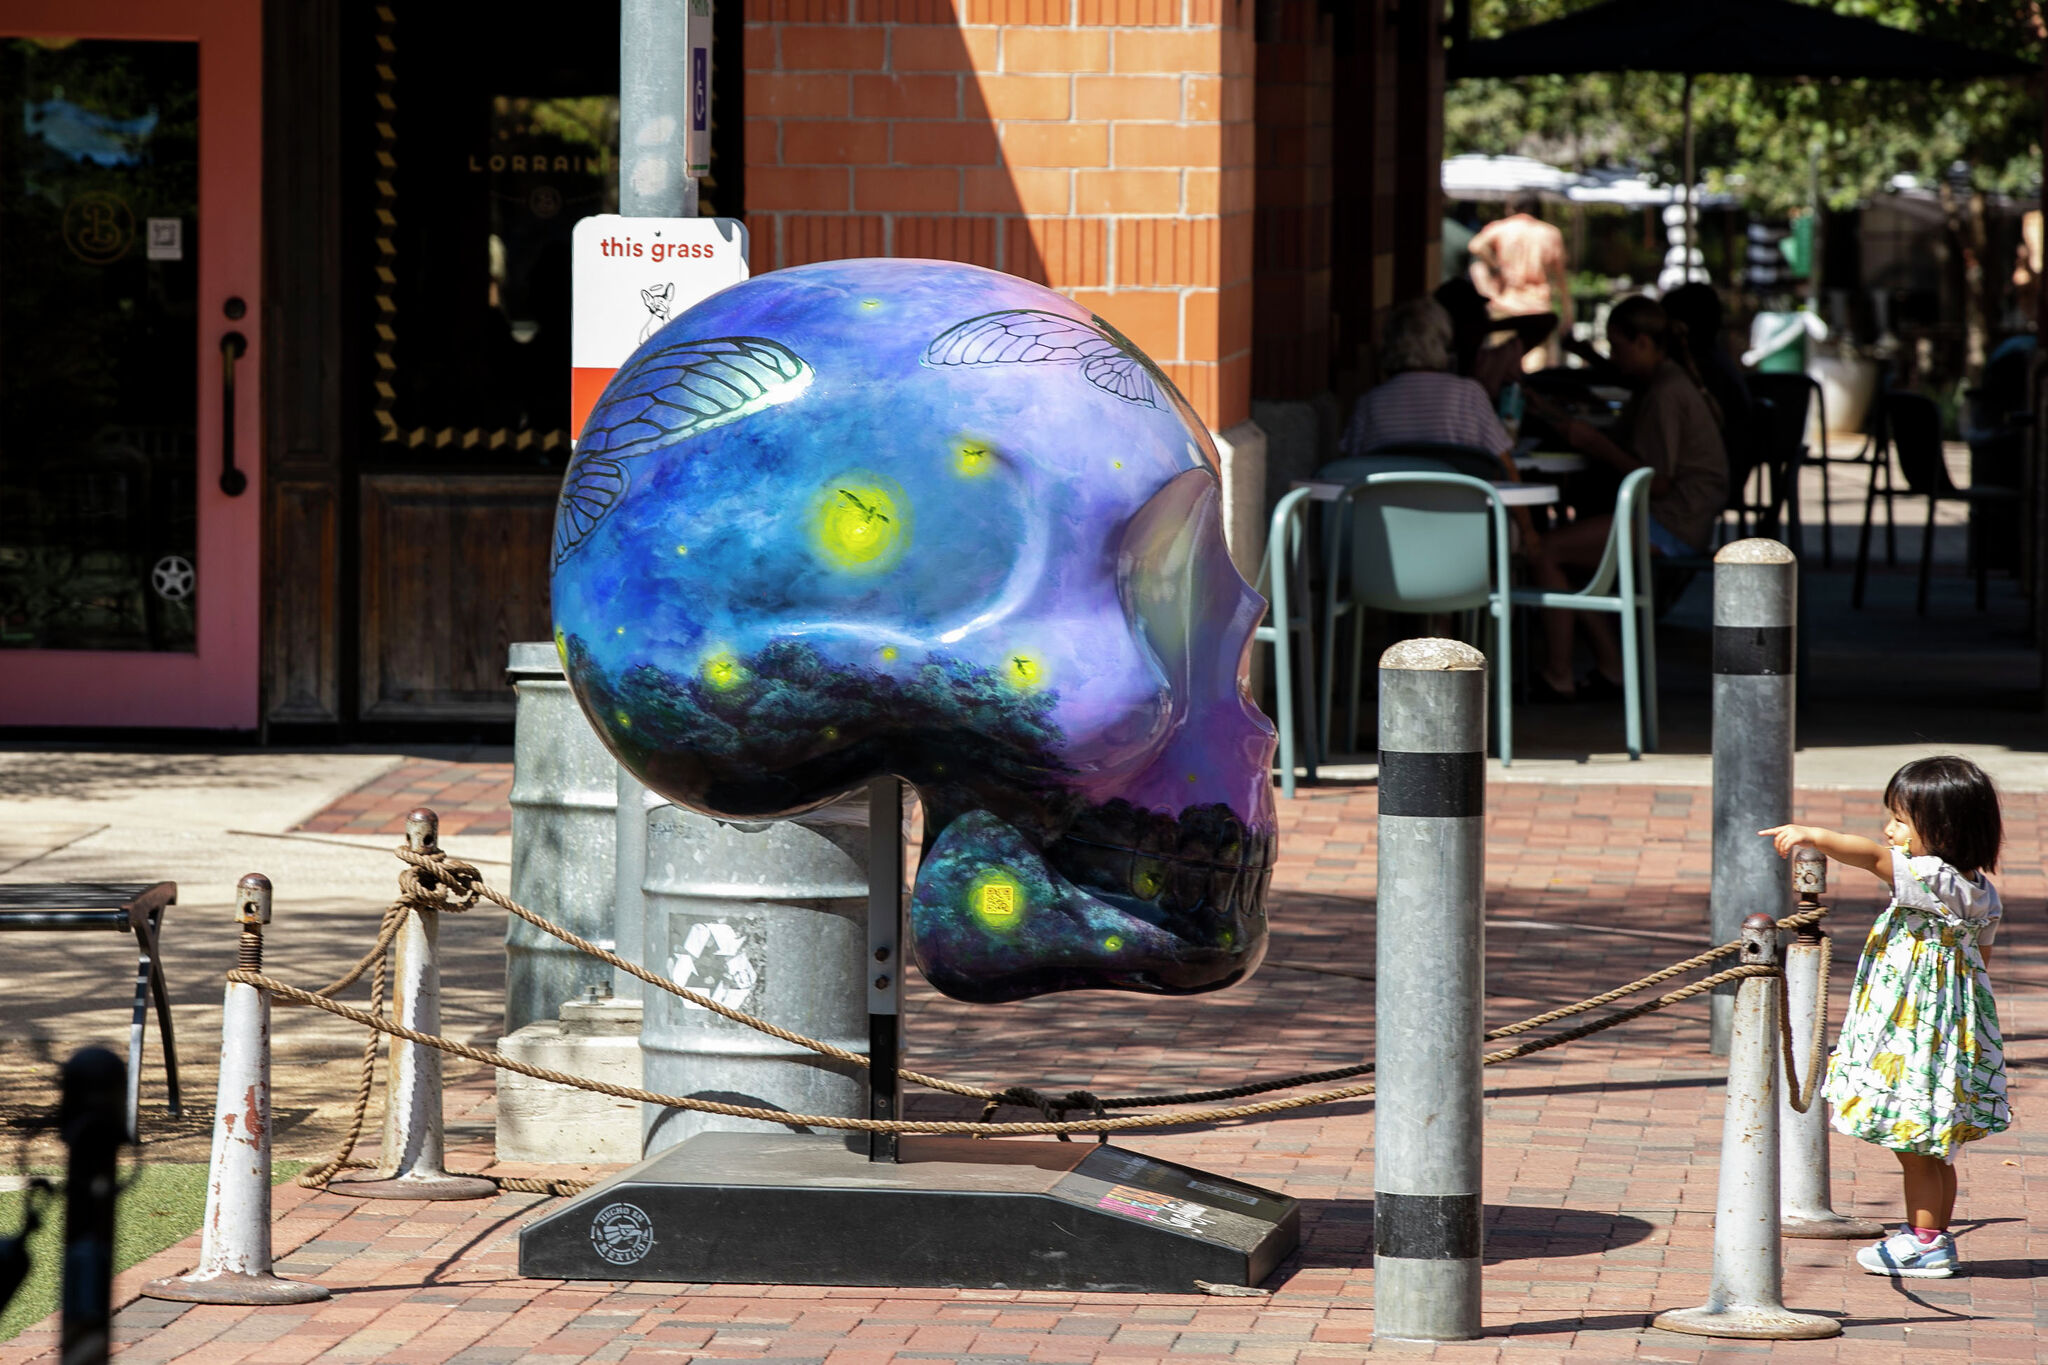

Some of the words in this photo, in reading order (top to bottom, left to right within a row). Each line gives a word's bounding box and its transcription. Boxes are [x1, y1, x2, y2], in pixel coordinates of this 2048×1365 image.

[600, 237, 643, 257] this
[651, 243, 714, 263] grass
[599, 1207, 630, 1224] HECHO
[631, 1210, 645, 1223] EN
